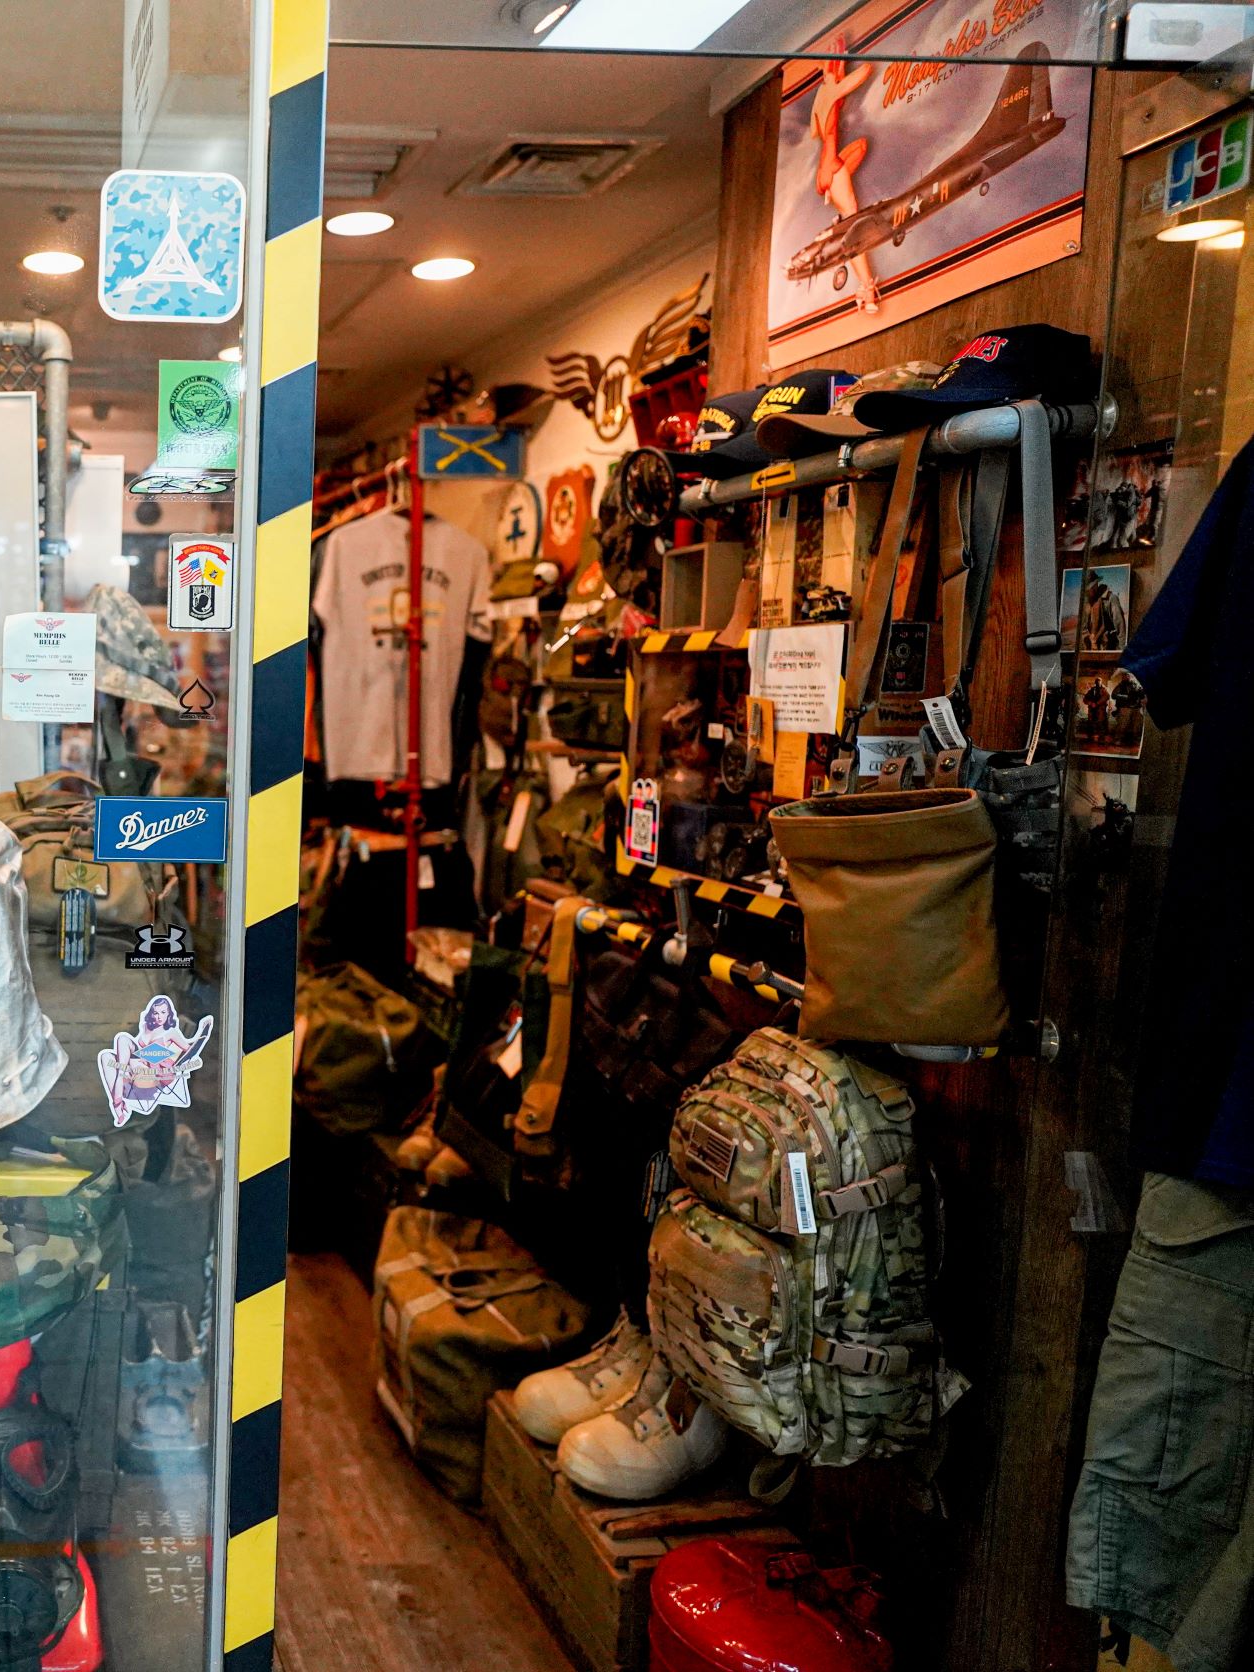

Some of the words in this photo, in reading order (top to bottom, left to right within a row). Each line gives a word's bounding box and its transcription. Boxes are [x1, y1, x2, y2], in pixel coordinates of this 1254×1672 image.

[883, 19, 986, 108] Memphis
[906, 83, 931, 104] B-17
[983, 5, 1045, 55] FORTRESS
[115, 807, 207, 851] Danner
